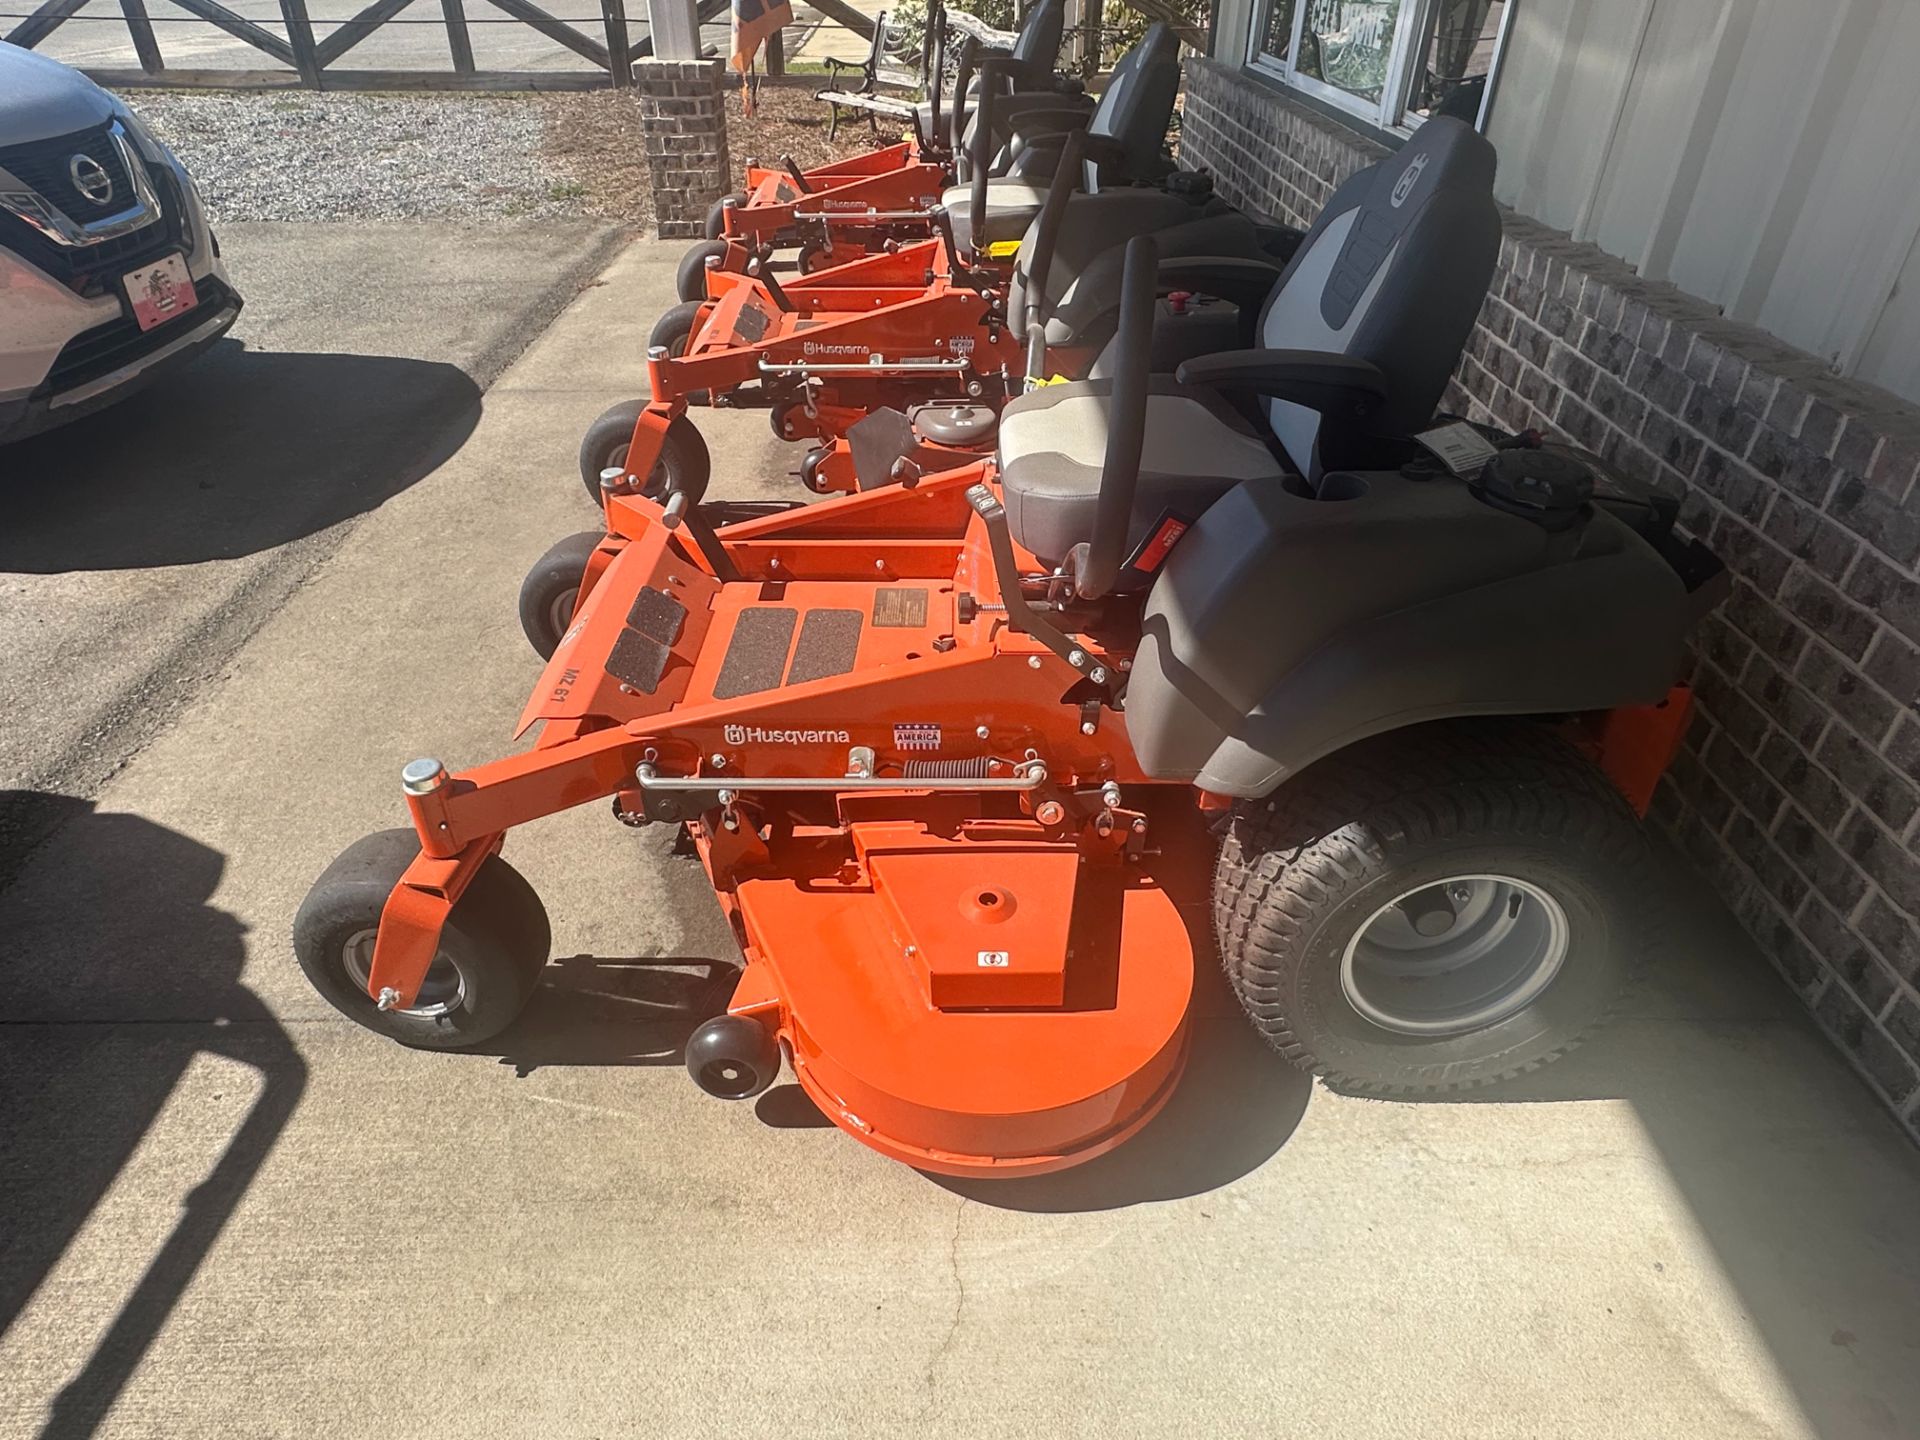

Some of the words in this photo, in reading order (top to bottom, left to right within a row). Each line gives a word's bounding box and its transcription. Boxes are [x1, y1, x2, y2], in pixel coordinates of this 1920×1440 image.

[815, 343, 870, 355] Husqvarna
[746, 727, 850, 745] Husqvarna
[897, 733, 938, 741] AMERICA
